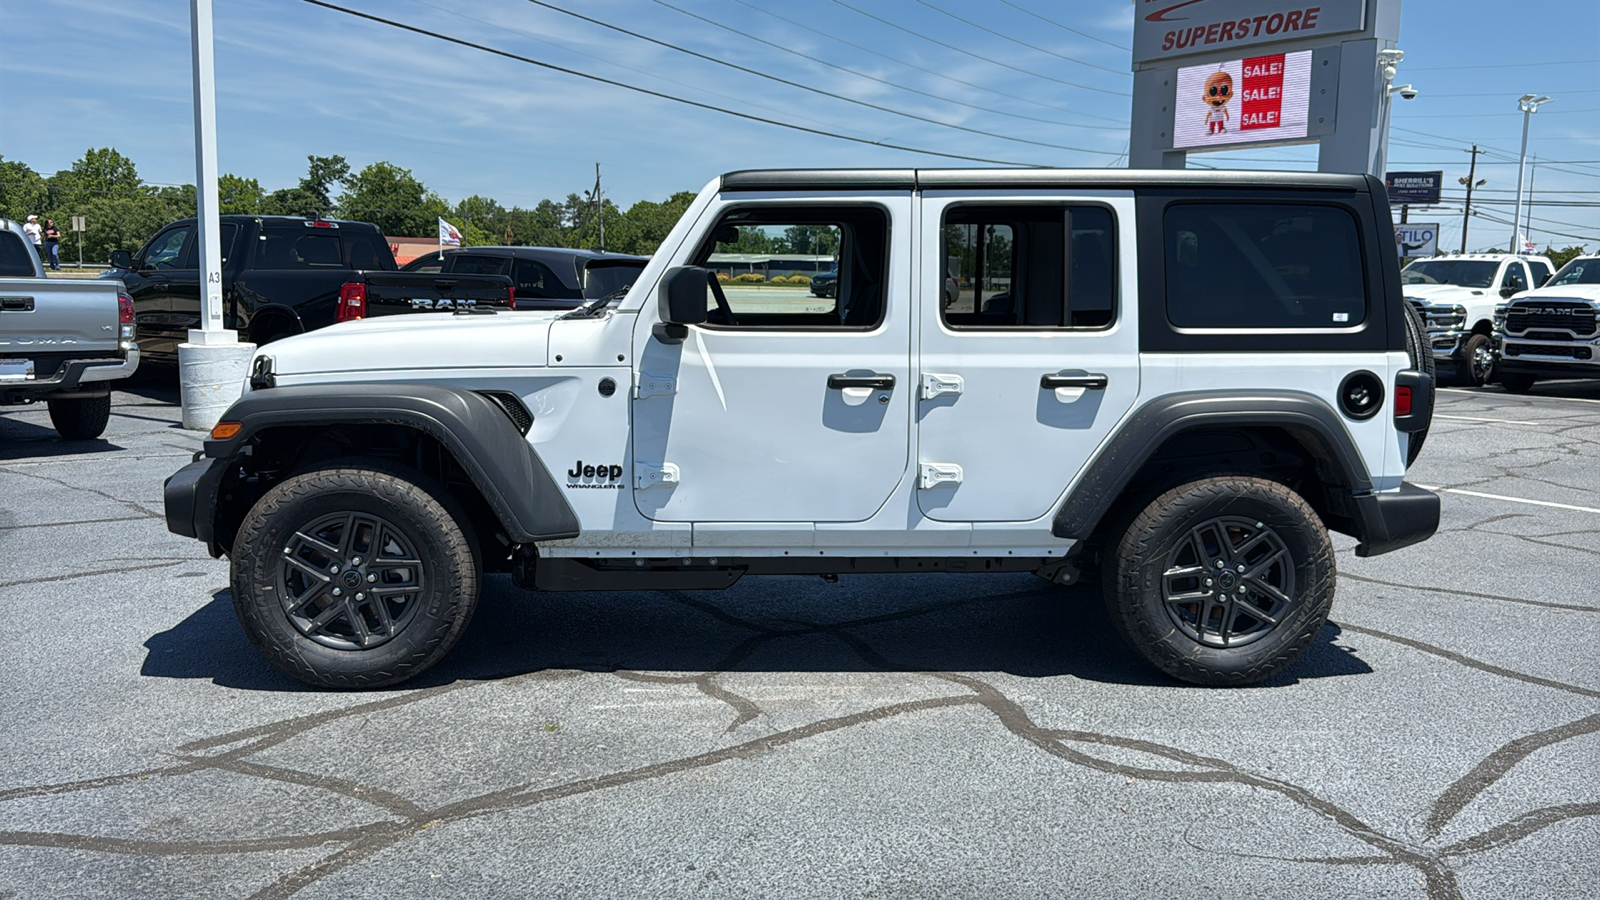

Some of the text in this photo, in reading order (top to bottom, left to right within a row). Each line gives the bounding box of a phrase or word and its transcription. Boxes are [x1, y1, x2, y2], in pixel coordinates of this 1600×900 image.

[1162, 7, 1321, 51] SUPERSTORE
[1243, 62, 1282, 78] SALE!
[1243, 87, 1280, 102] SALE!
[1242, 111, 1279, 126] SALE!
[208, 271, 221, 284] A3
[411, 298, 477, 310] RAM
[1528, 307, 1571, 315] RAM
[568, 460, 623, 481] Jeep
